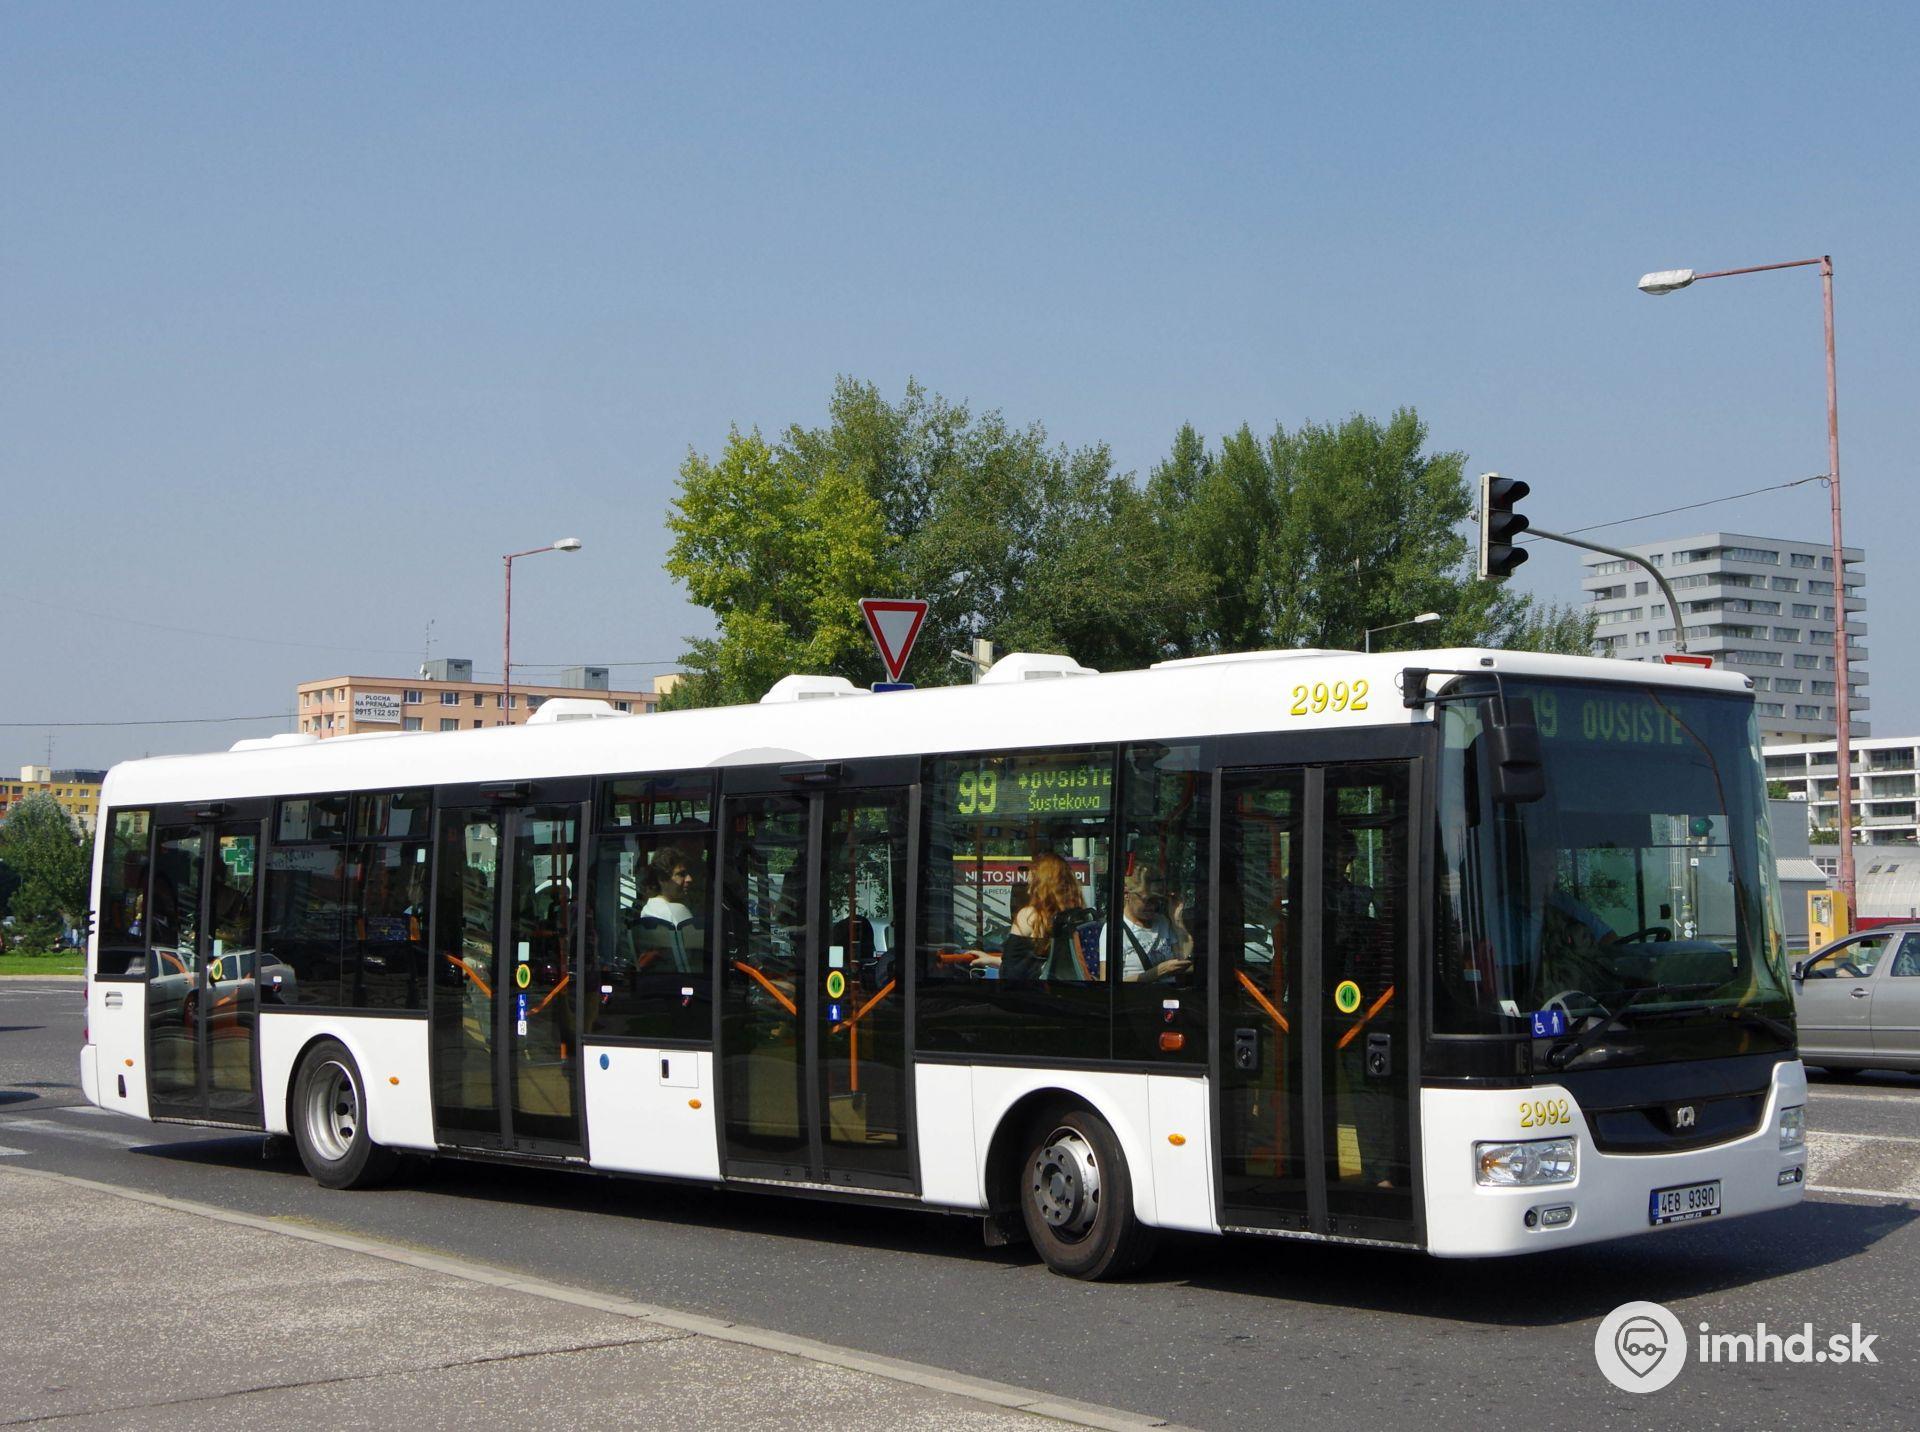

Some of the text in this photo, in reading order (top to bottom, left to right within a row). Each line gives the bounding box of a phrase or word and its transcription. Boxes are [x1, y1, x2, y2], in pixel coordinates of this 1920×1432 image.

[1290, 680, 1369, 716] 2992
[387, 709, 400, 717] 557
[958, 770, 997, 814] 99
[1028, 790, 1100, 811] Šustekova
[1005, 871, 1015, 882] SI
[1519, 1098, 1571, 1127] 2992
[1688, 1187, 1715, 1209] 9390
